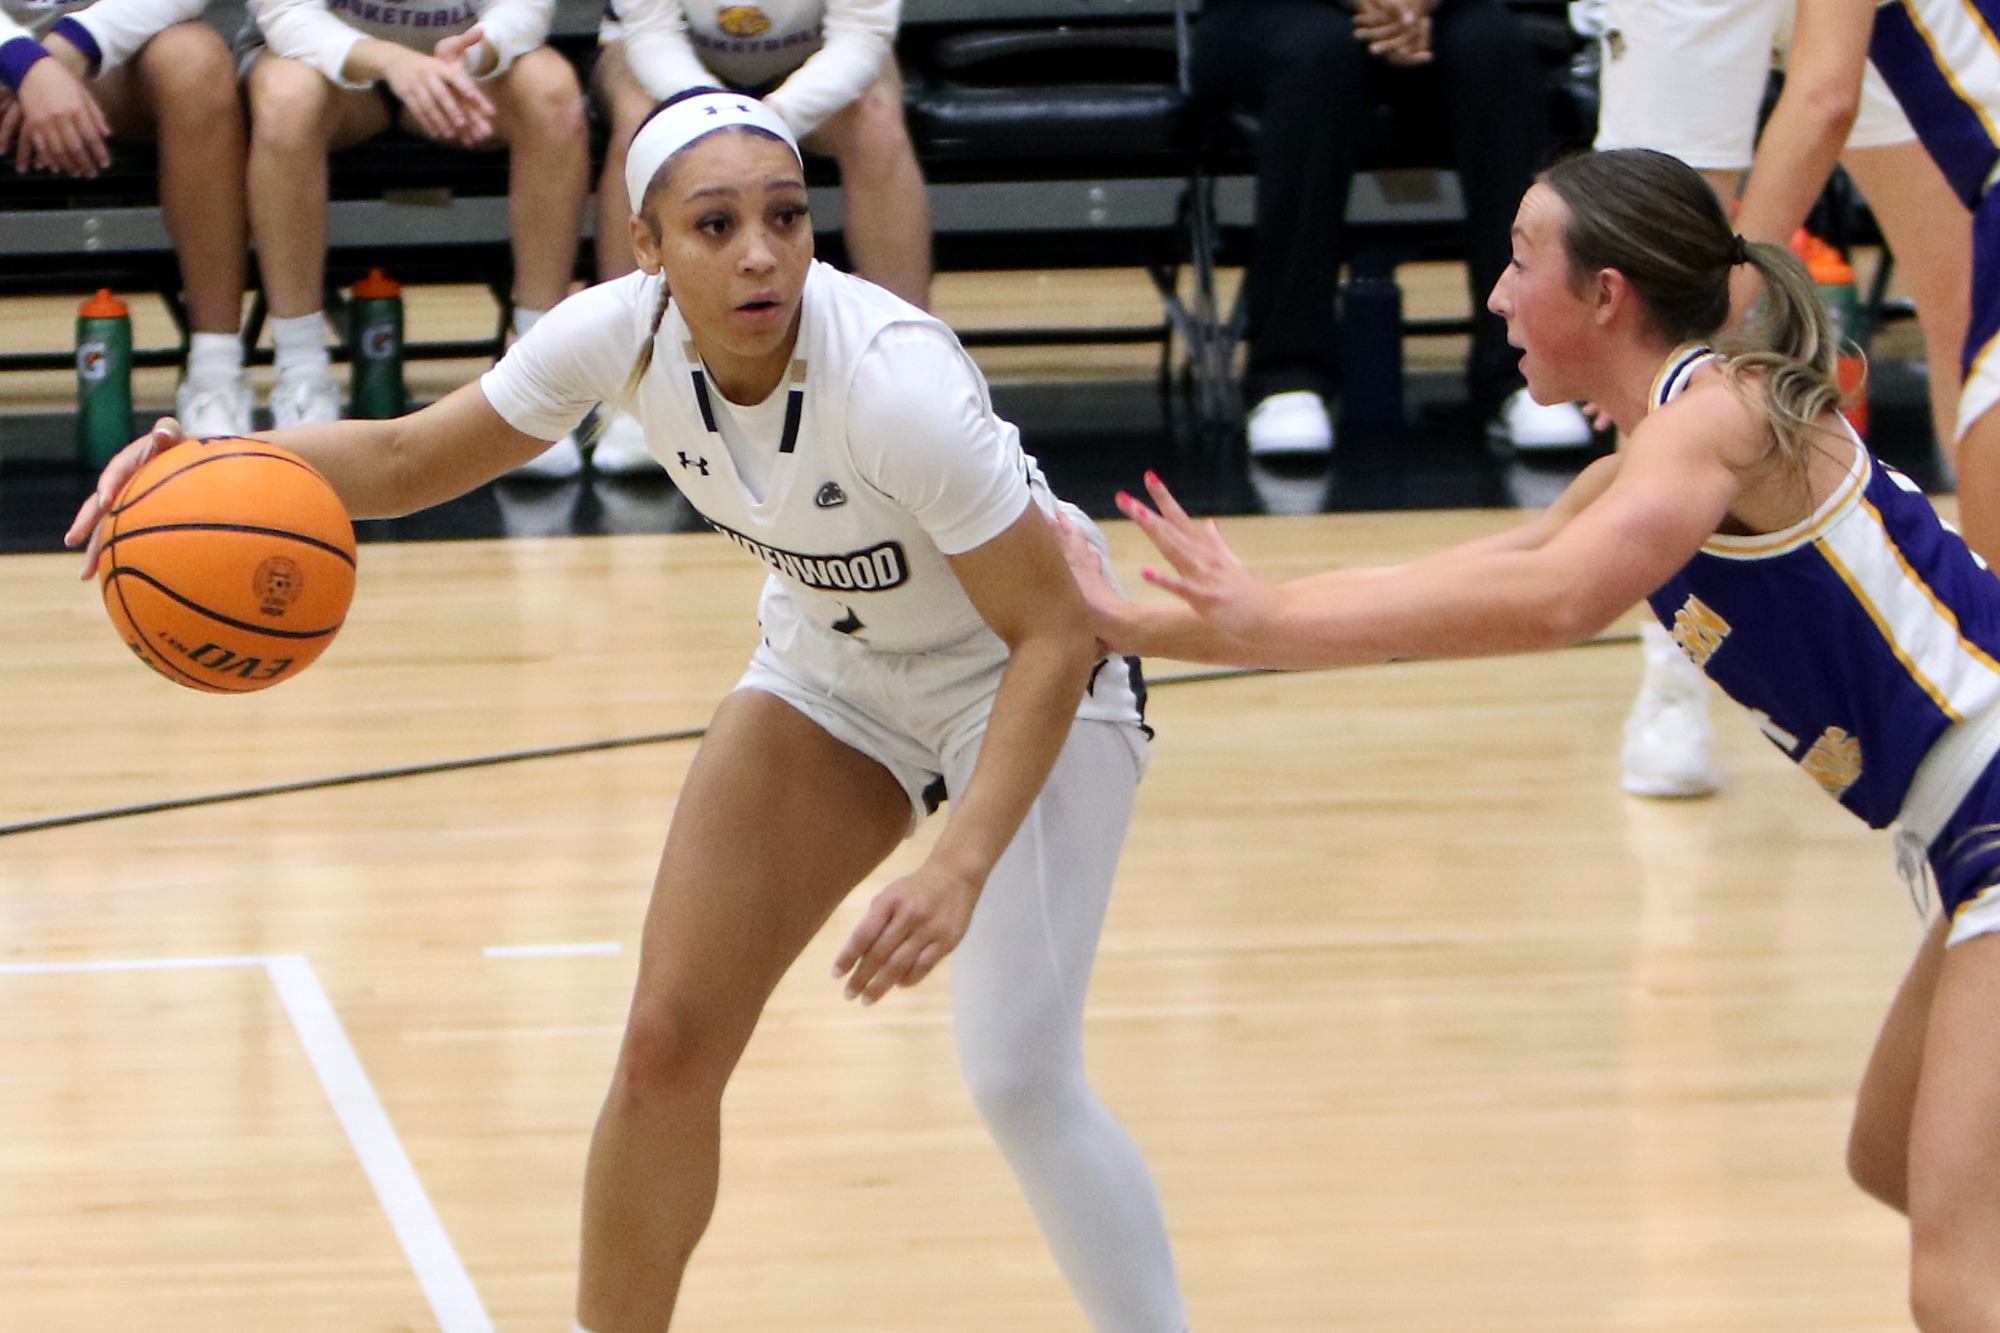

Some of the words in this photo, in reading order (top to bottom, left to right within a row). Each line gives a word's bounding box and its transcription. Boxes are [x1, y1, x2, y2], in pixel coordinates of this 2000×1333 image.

[363, 323, 396, 360] G
[77, 342, 107, 381] G
[188, 644, 294, 681] EVO
